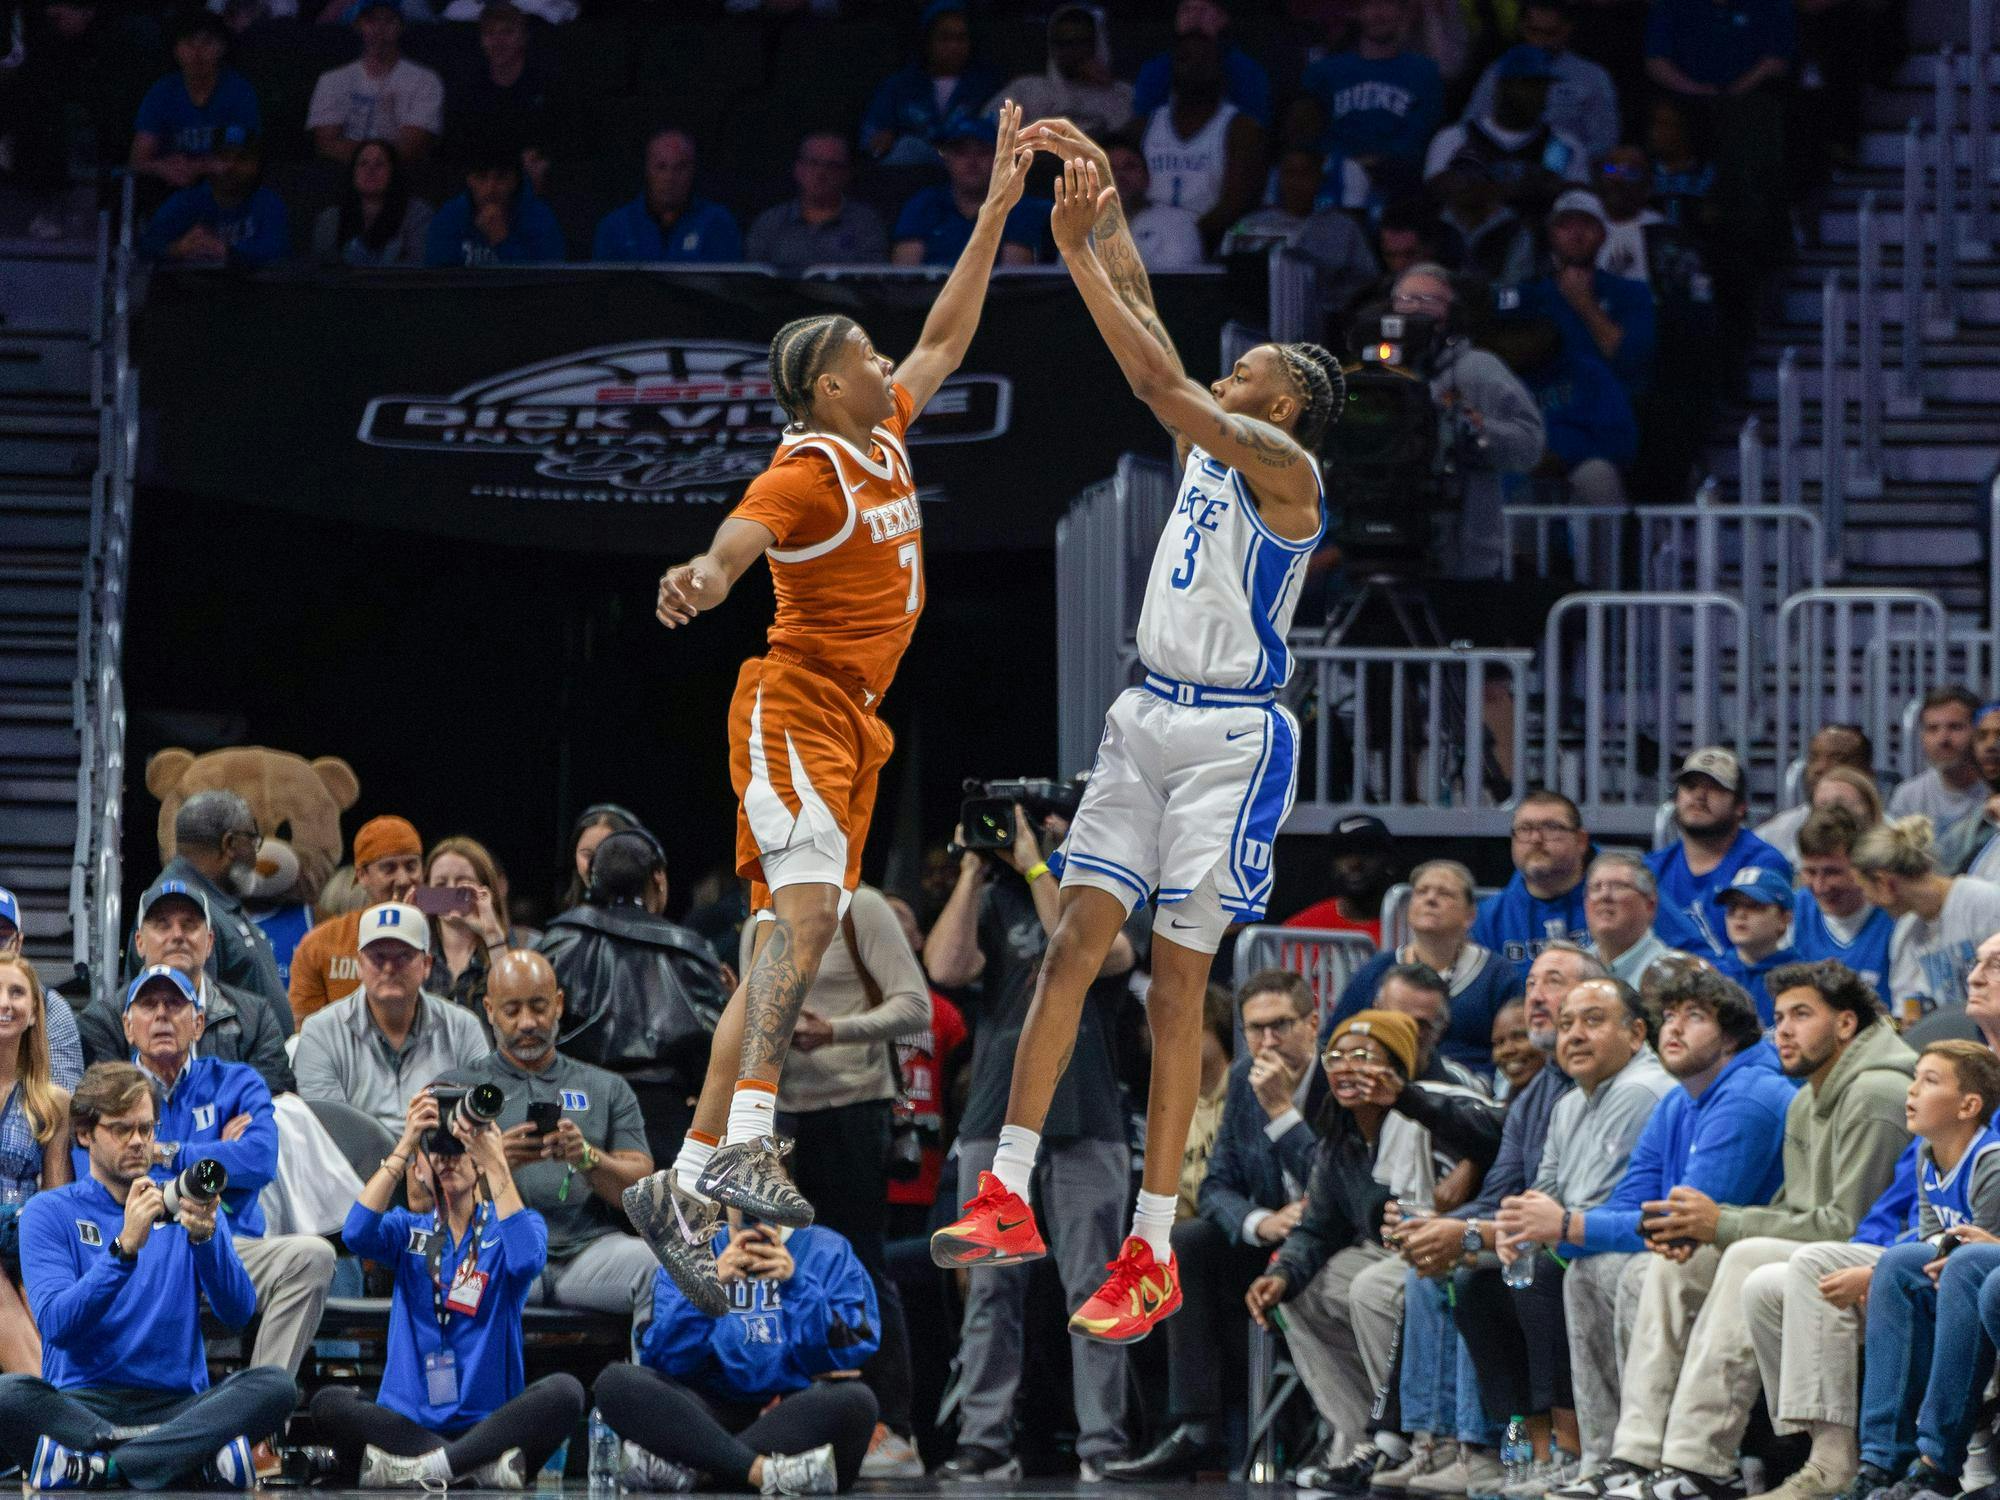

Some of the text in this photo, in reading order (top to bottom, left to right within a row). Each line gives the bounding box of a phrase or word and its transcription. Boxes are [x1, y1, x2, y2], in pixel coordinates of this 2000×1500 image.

[403, 406, 634, 430] DICK
[1171, 524, 1201, 590] 3
[898, 542, 919, 614] 7
[1177, 683, 1194, 705] D
[1242, 838, 1270, 870] D
[377, 909, 400, 928] D
[560, 1089, 589, 1111] D
[191, 1102, 215, 1132] D
[76, 1219, 102, 1247] D
